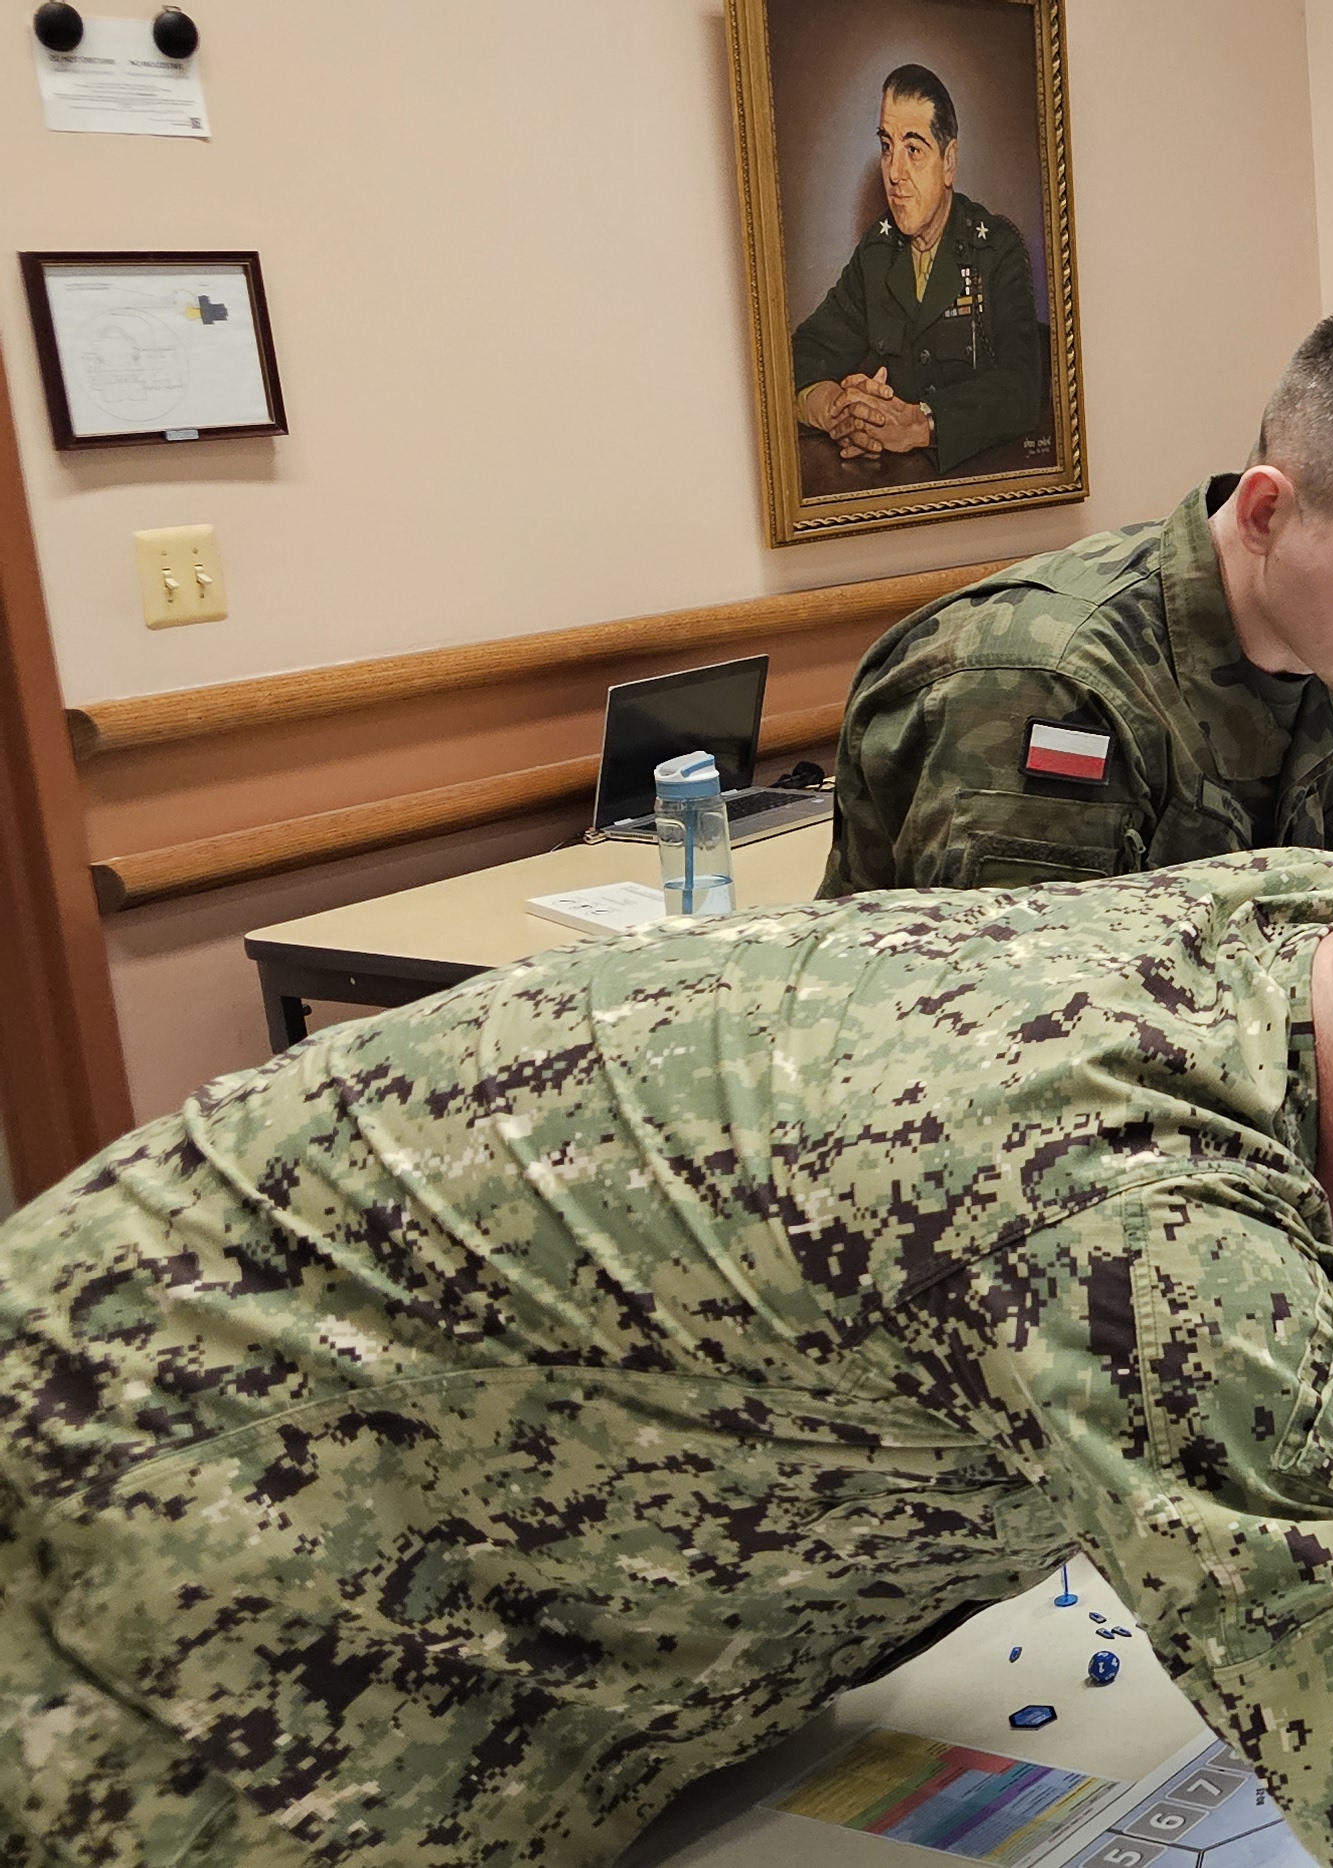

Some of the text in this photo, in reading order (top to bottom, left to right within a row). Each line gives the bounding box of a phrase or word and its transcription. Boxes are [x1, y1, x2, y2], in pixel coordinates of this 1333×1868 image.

[1186, 1778, 1222, 1796] 7
[1150, 1812, 1186, 1830] 6
[1103, 1849, 1142, 1868] 5
